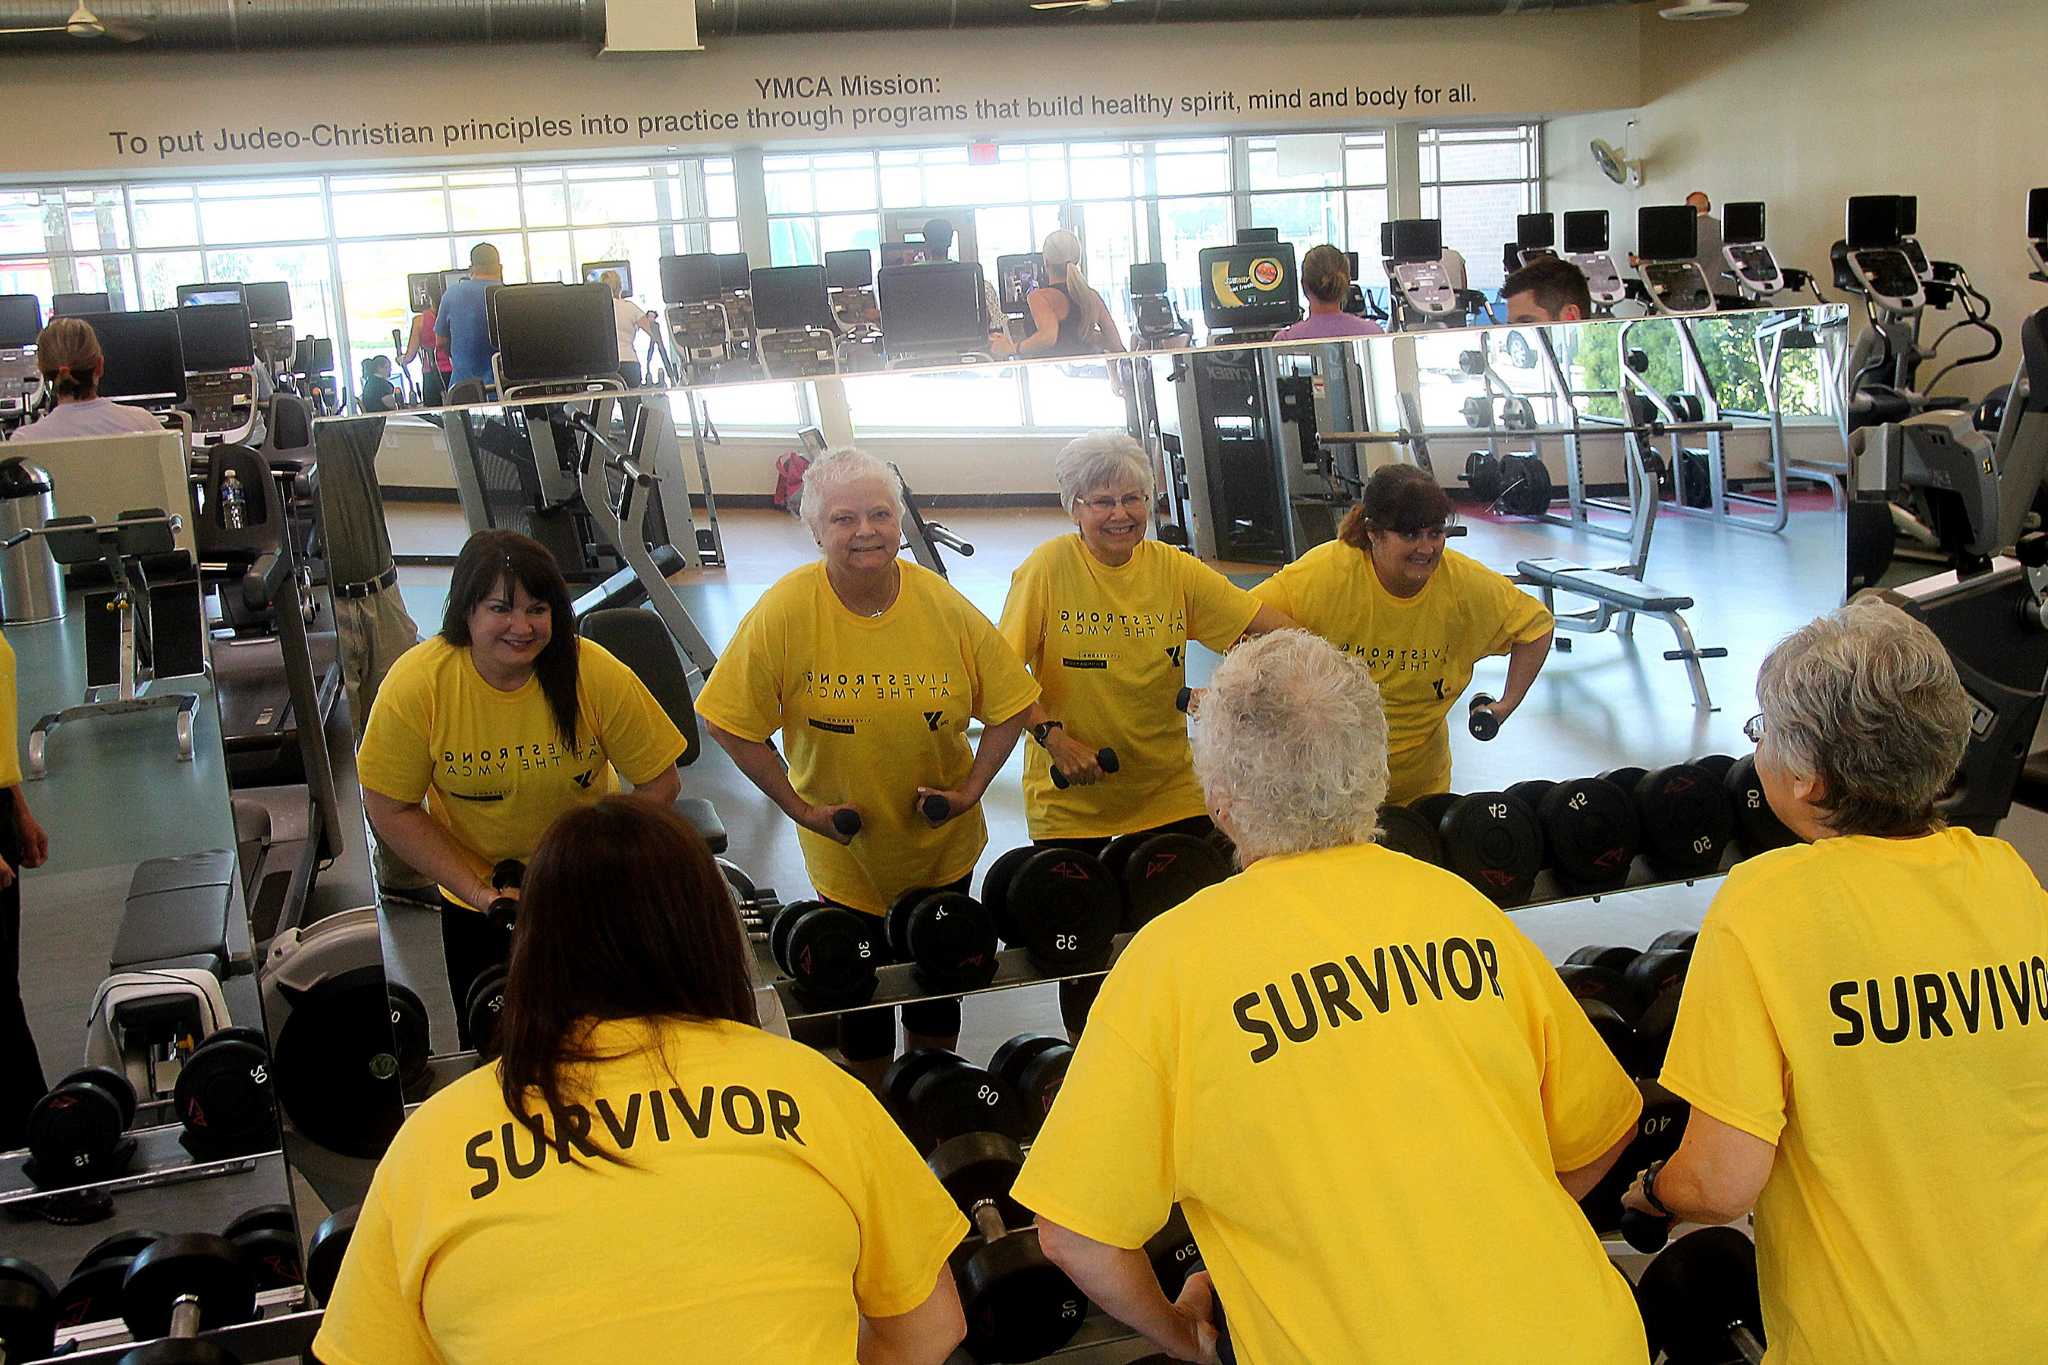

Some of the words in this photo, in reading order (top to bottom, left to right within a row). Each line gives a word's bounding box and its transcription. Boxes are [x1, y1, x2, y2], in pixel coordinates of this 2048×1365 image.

[109, 131, 148, 155] To
[158, 129, 205, 160] put
[213, 121, 434, 152] Judeo-Christian
[443, 115, 573, 147] principles
[580, 113, 629, 136] into
[638, 109, 740, 138] practice
[746, 104, 844, 132] through
[852, 101, 968, 129] programs
[974, 97, 1020, 121] that
[1027, 95, 1085, 118] build
[1091, 93, 1174, 118] healthy
[1181, 90, 1242, 118] spirit,
[1248, 88, 1302, 111] mind
[1308, 87, 1348, 108] and
[1355, 84, 1407, 110] body
[1414, 83, 1442, 104] for
[1448, 83, 1477, 103] all.
[754, 75, 833, 100] YMCA
[841, 73, 941, 97] Mission:
[1232, 936, 1505, 1064] SURVIVOR
[465, 1085, 807, 1200] SURVIVOR
